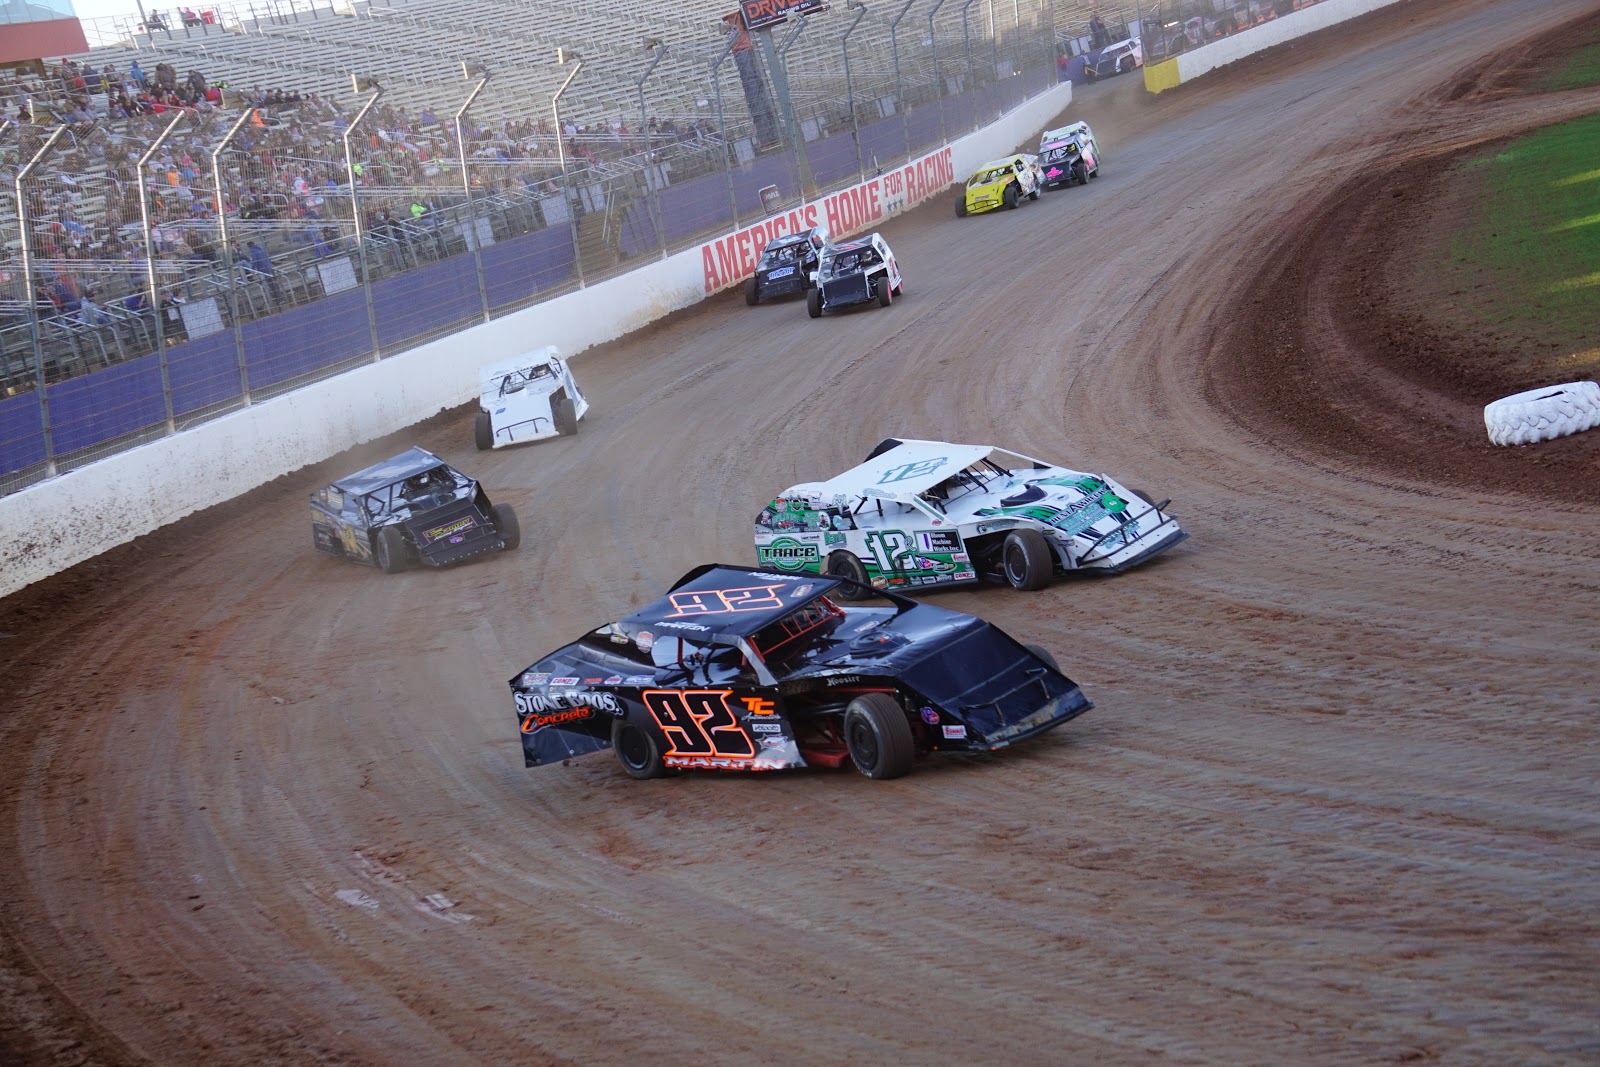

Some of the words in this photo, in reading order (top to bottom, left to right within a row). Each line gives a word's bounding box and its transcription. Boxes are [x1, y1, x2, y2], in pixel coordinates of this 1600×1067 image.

[824, 180, 882, 239] HOME
[883, 171, 903, 197] FOR
[905, 146, 954, 204] RACING
[826, 675, 861, 687] Hoosier
[740, 697, 775, 715] TC
[642, 688, 756, 758] 92
[662, 755, 787, 771] MARTIN
